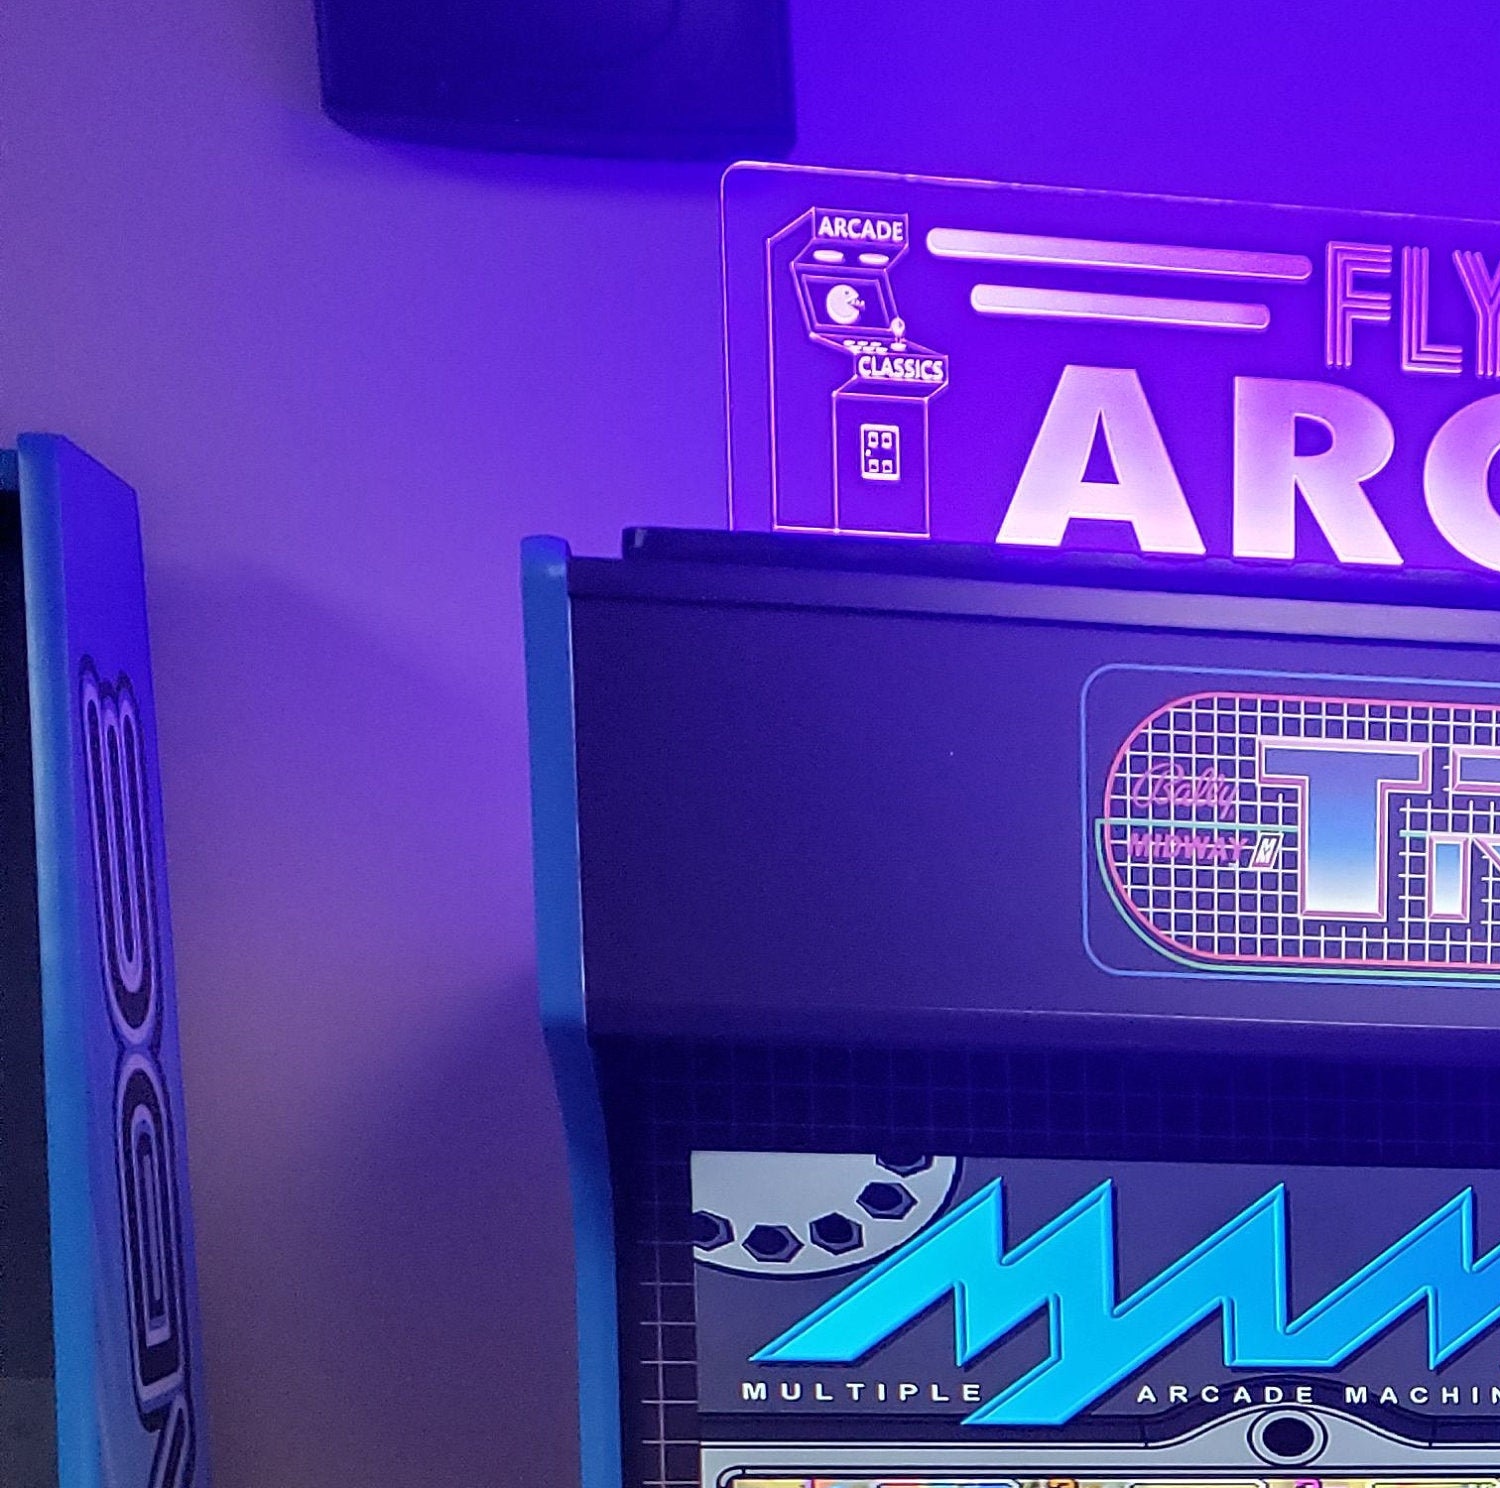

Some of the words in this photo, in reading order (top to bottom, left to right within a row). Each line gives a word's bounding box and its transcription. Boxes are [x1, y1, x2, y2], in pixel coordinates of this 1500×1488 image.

[818, 215, 903, 242] ARCADE
[858, 355, 944, 381] CLASSICS
[1132, 762, 1237, 820] Bally
[1128, 833, 1250, 862] MIDWAY
[742, 1382, 983, 1403] MULTIPLE
[1137, 1384, 1315, 1405] ARCADE
